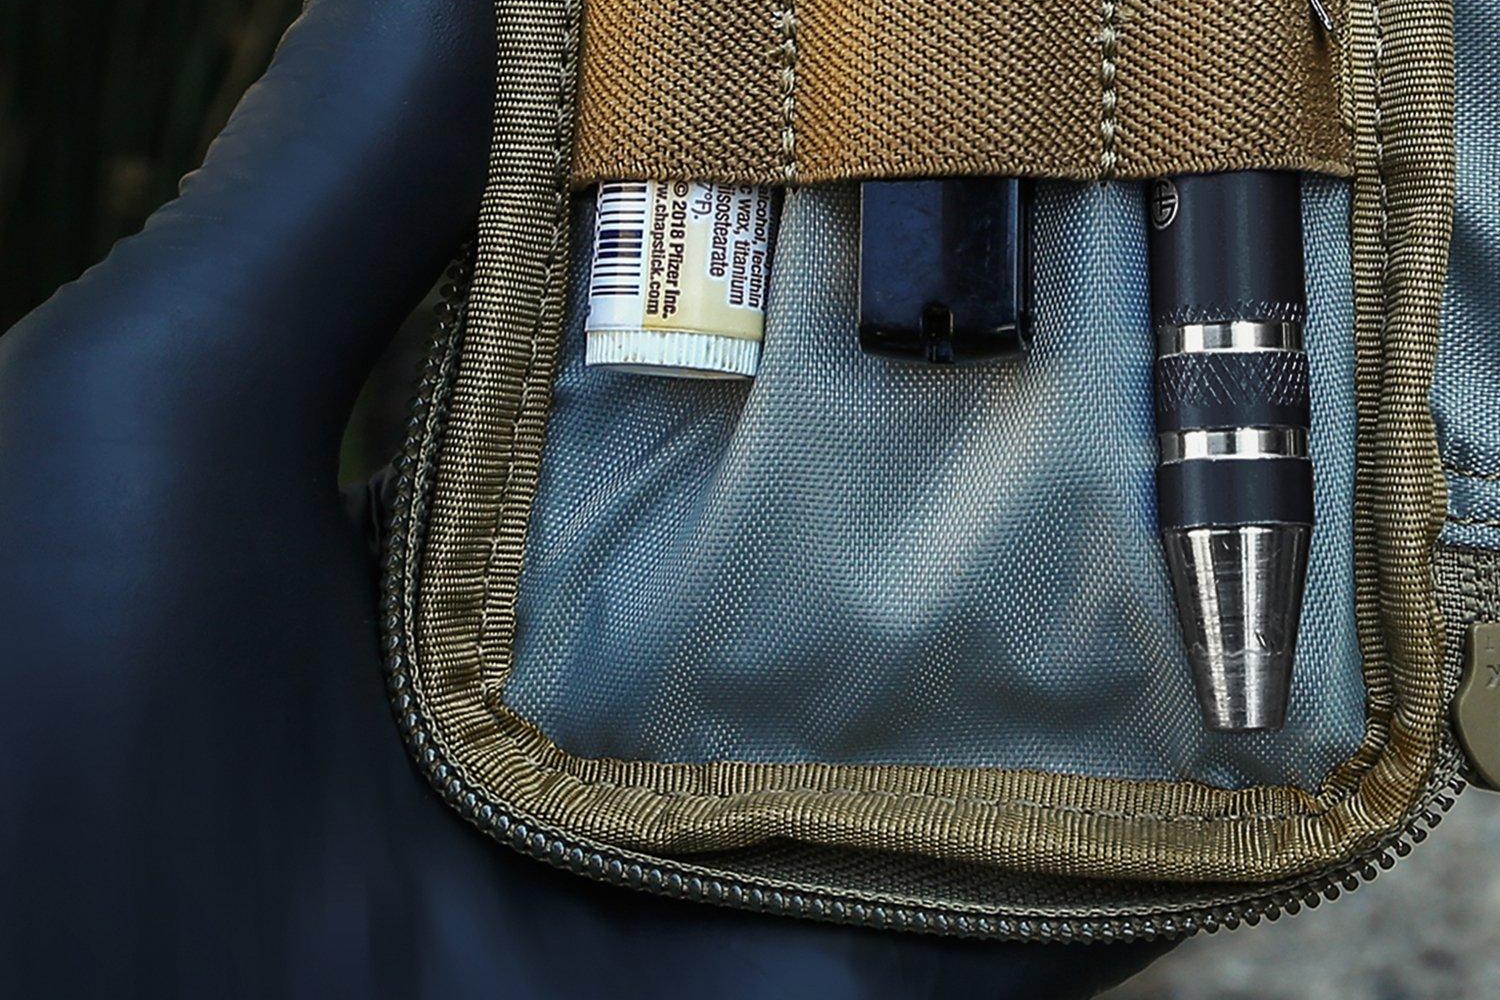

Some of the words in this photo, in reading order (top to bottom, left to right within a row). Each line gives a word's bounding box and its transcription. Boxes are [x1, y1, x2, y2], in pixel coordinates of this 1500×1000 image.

[670, 200, 687, 239] 2018
[733, 199, 751, 235] wax,
[665, 243, 684, 287] Pfizer
[729, 240, 750, 306] titanium
[748, 250, 766, 309] lecithin
[661, 289, 680, 319] Inc.
